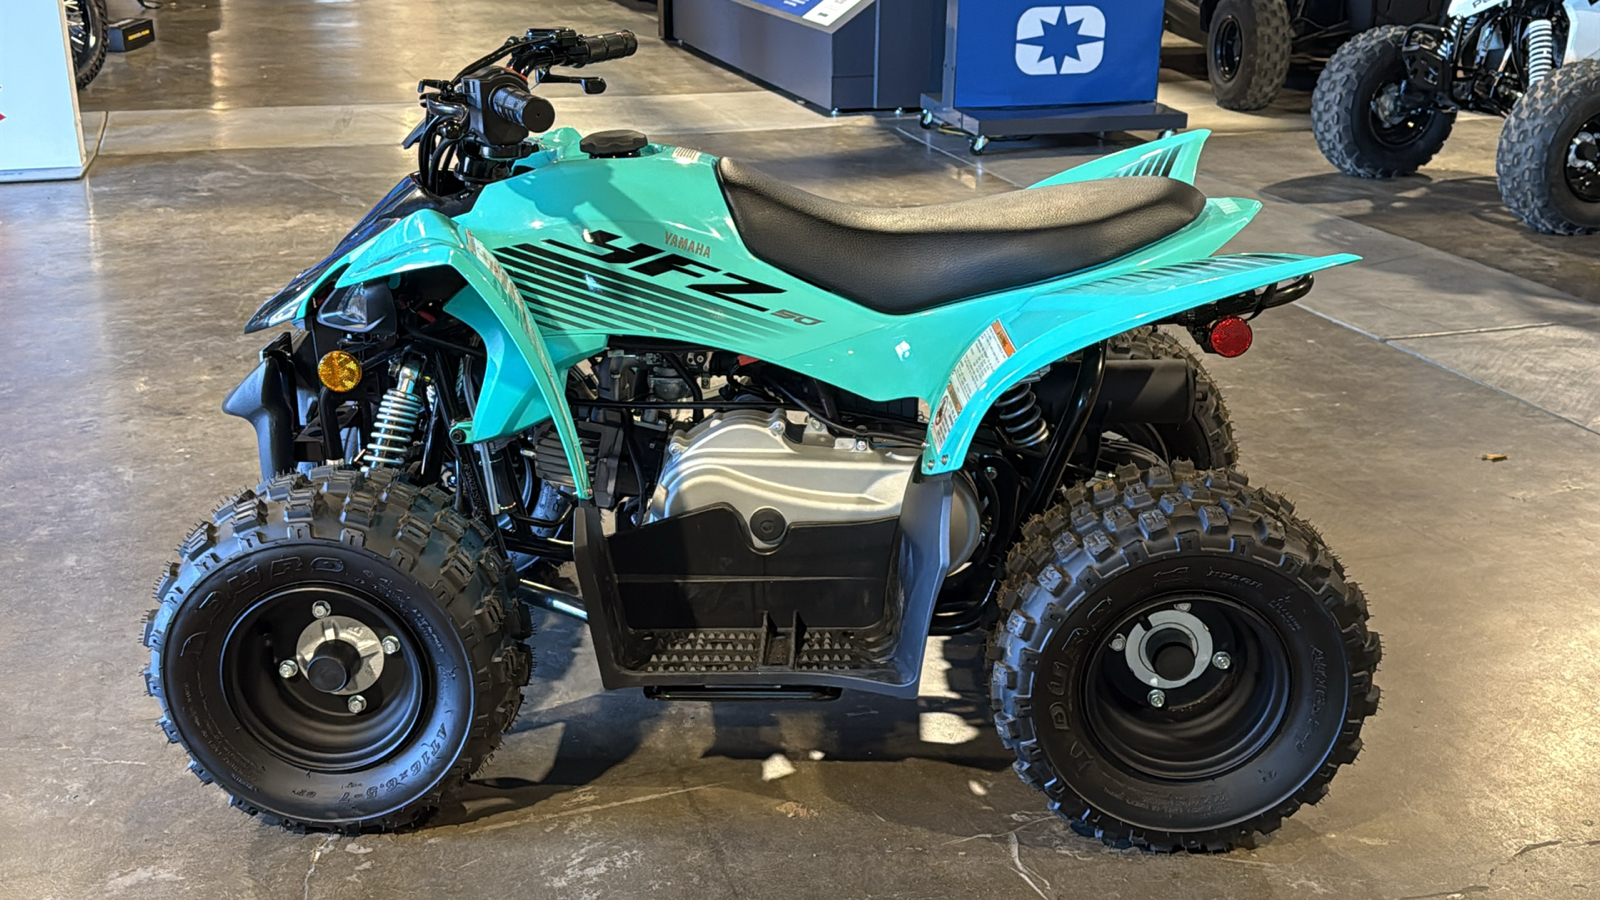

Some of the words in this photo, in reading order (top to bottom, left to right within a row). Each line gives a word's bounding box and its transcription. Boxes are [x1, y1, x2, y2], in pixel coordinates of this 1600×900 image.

[665, 231, 711, 259] YAMAHA
[583, 230, 788, 312] YFZ
[769, 309, 826, 326] 50
